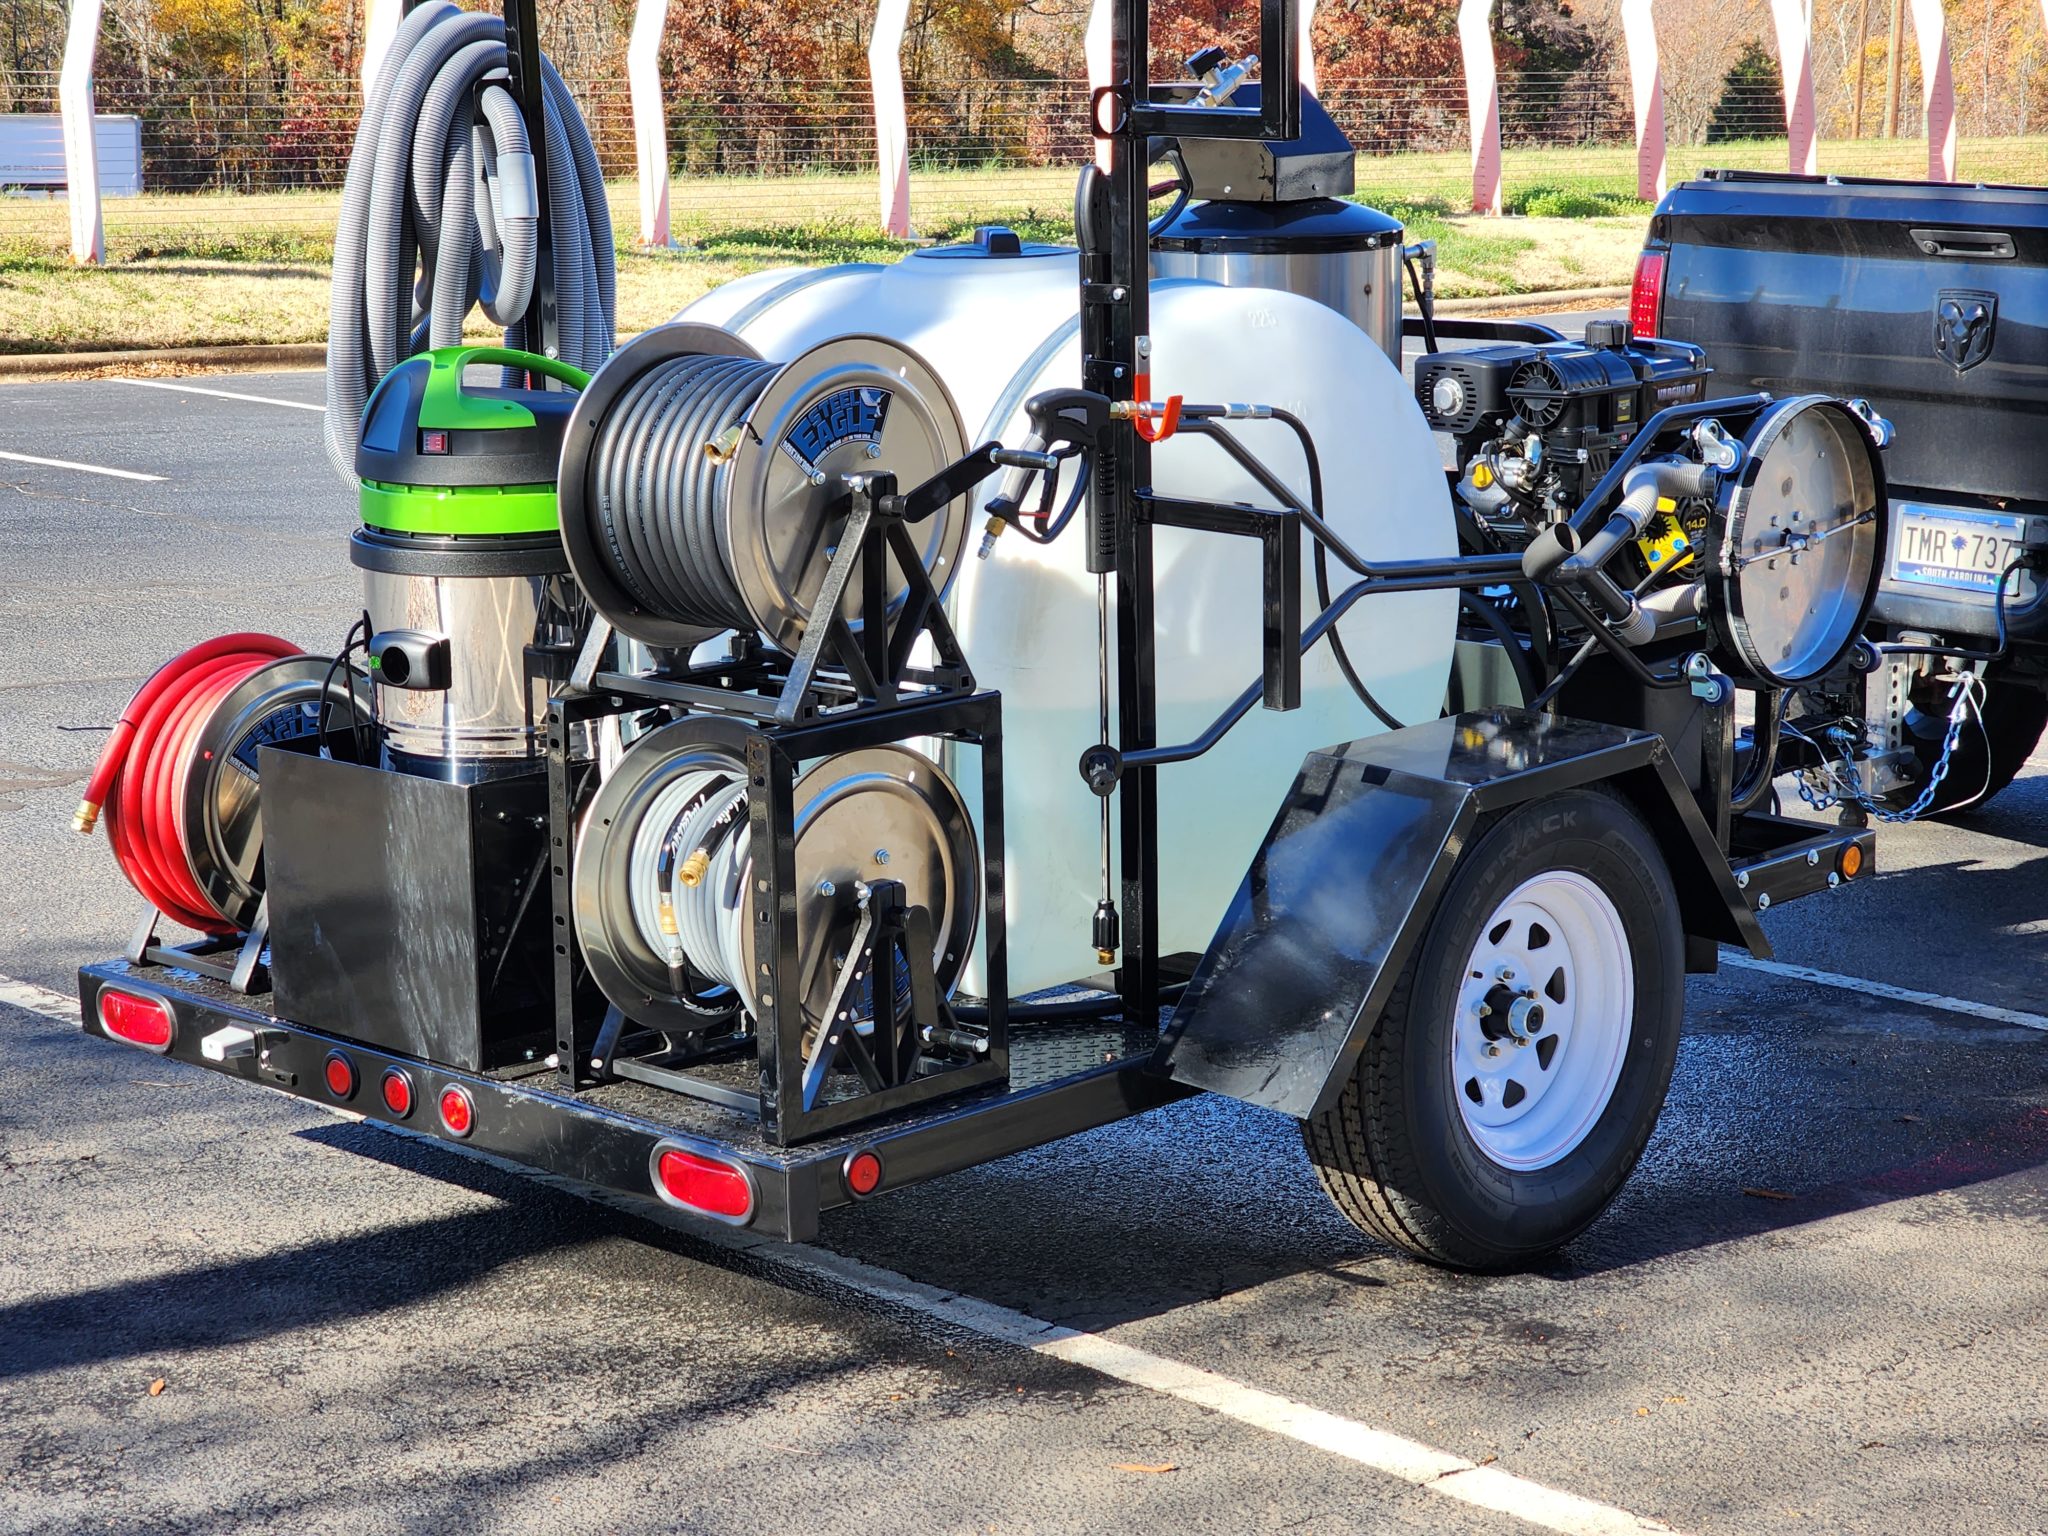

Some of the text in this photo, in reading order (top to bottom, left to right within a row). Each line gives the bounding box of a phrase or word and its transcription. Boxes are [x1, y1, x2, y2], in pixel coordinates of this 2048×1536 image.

[808, 390, 861, 424] STEEL
[788, 388, 883, 461] EAGLE
[1686, 516, 1707, 530] 14.0
[1906, 526, 2014, 571] TMR 737
[1922, 566, 1947, 579] SOUTH
[1949, 571, 1988, 584] CAROLINA
[252, 705, 302, 740] STEEL
